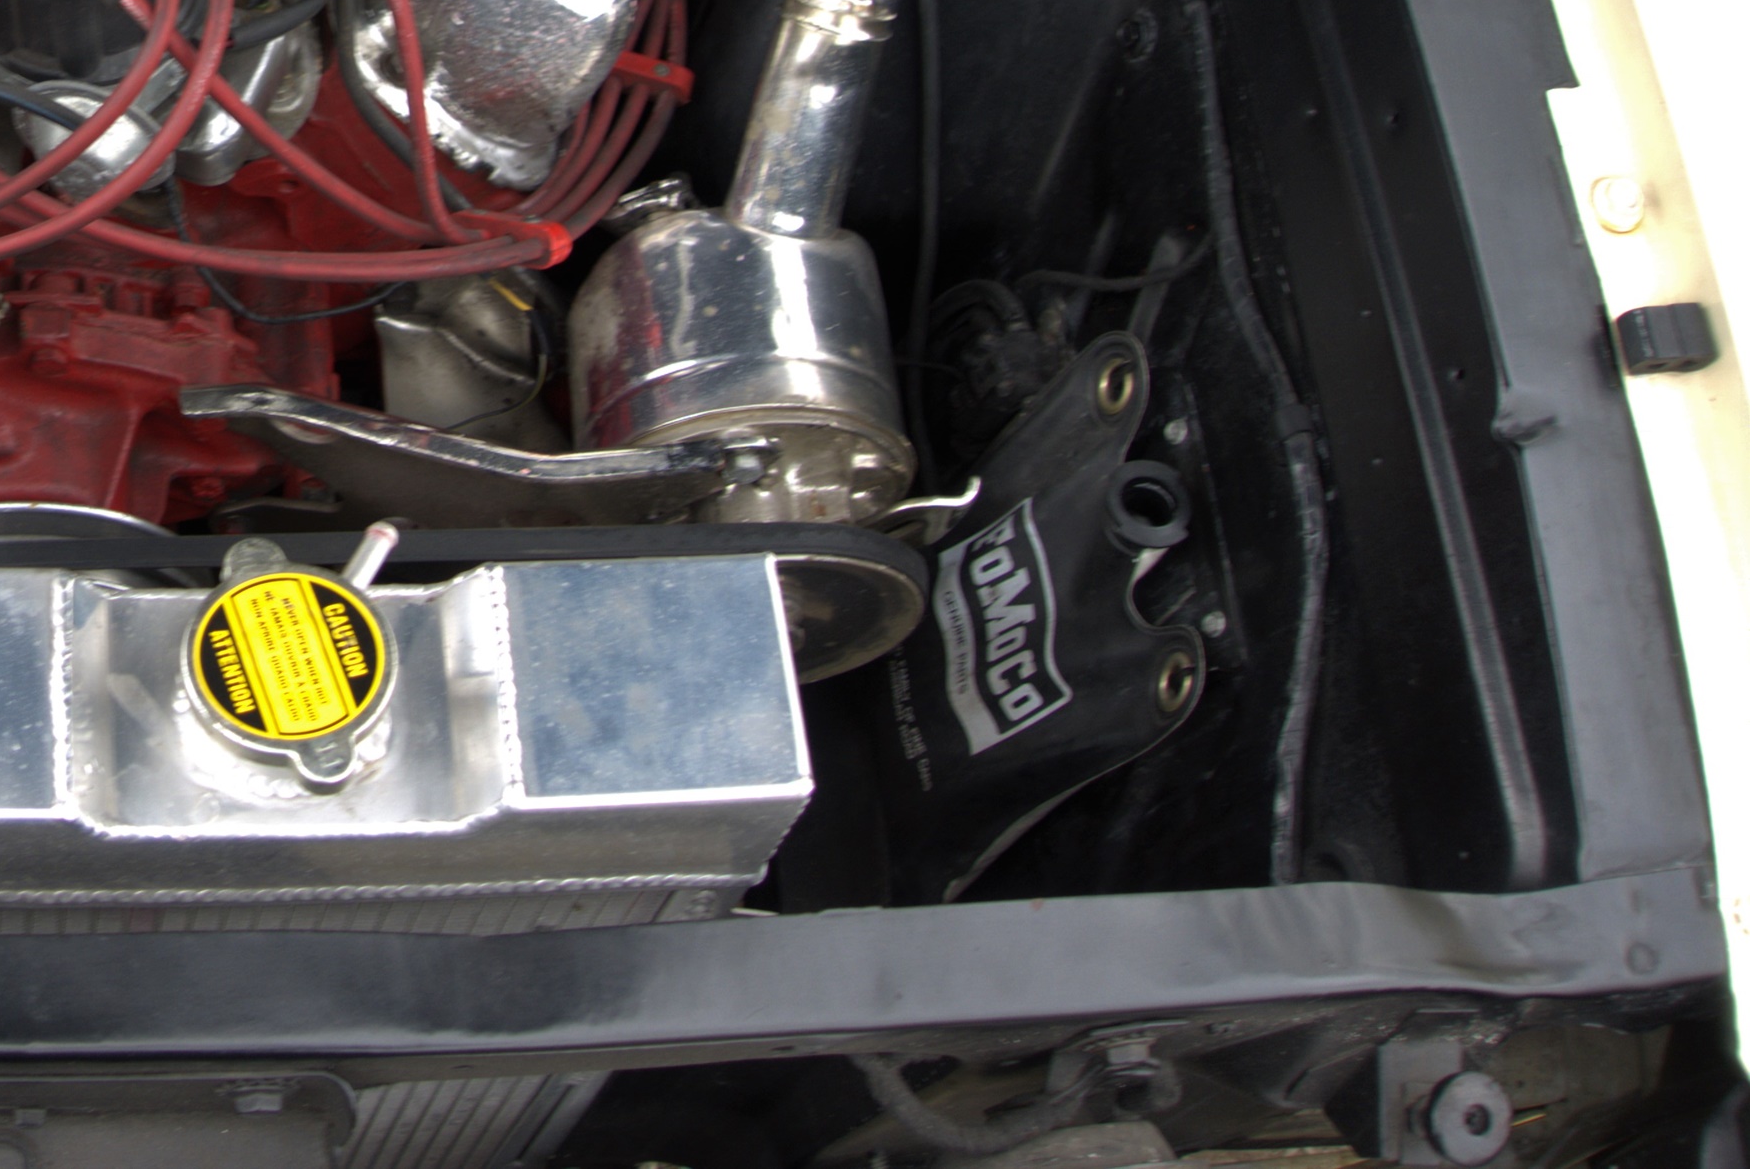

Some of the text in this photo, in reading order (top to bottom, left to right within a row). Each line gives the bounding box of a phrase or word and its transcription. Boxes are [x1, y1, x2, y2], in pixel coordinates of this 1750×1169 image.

[281, 597, 300, 627] NEVER
[323, 602, 369, 678] CAUTION
[943, 590, 969, 695] GENUINE PARTS
[208, 629, 256, 714] ATTENTION
